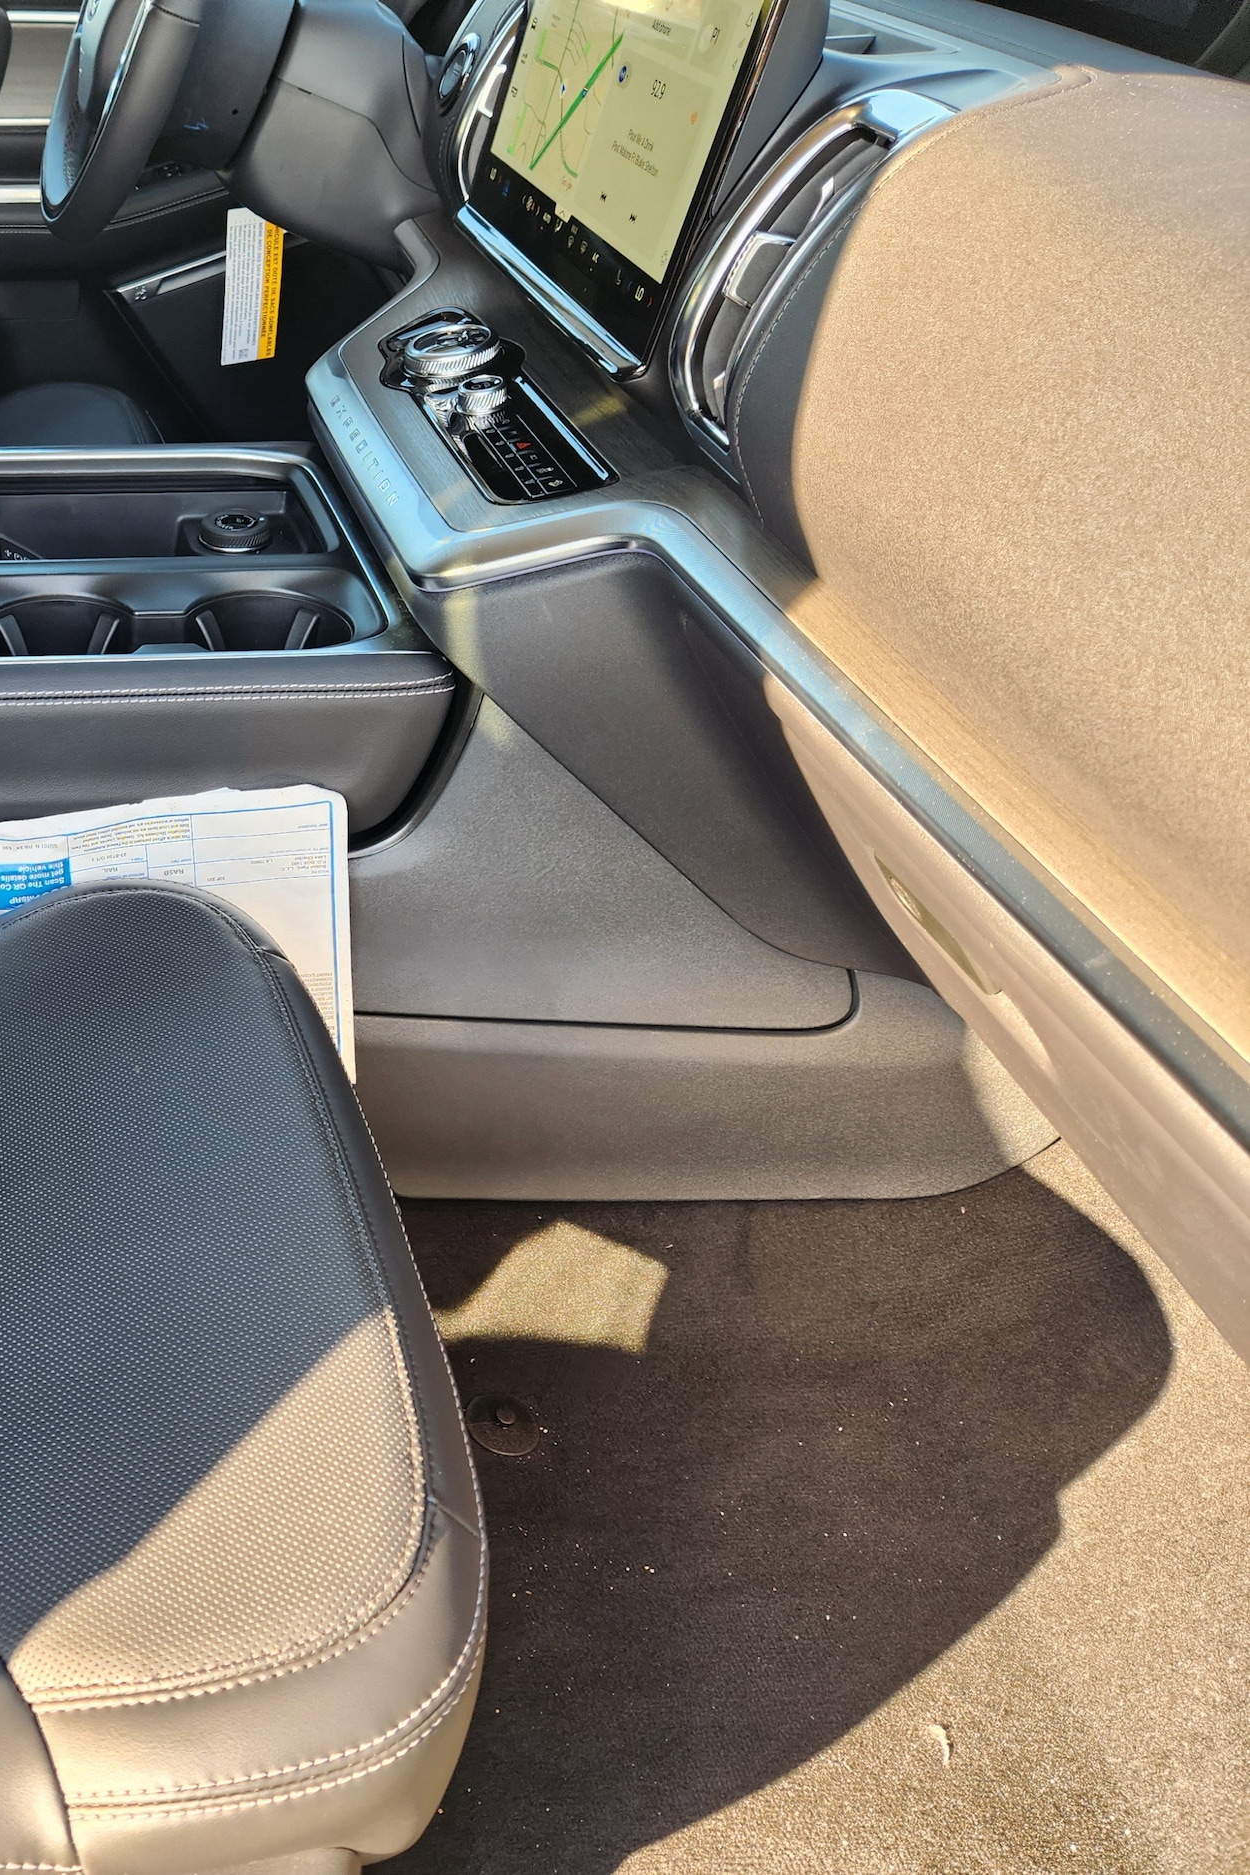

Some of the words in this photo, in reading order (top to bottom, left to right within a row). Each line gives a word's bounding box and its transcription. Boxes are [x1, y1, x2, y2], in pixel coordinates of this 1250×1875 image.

[710, 27, 720, 45] P1
[266, 230, 271, 238] DE
[330, 395, 400, 507] EXPEDITION
[18, 863, 46, 873] vehicle
[48, 861, 64, 870] this
[29, 872, 50, 880] more
[50, 868, 64, 878] get
[28, 880, 43, 889] The
[44, 877, 64, 886] Scan
